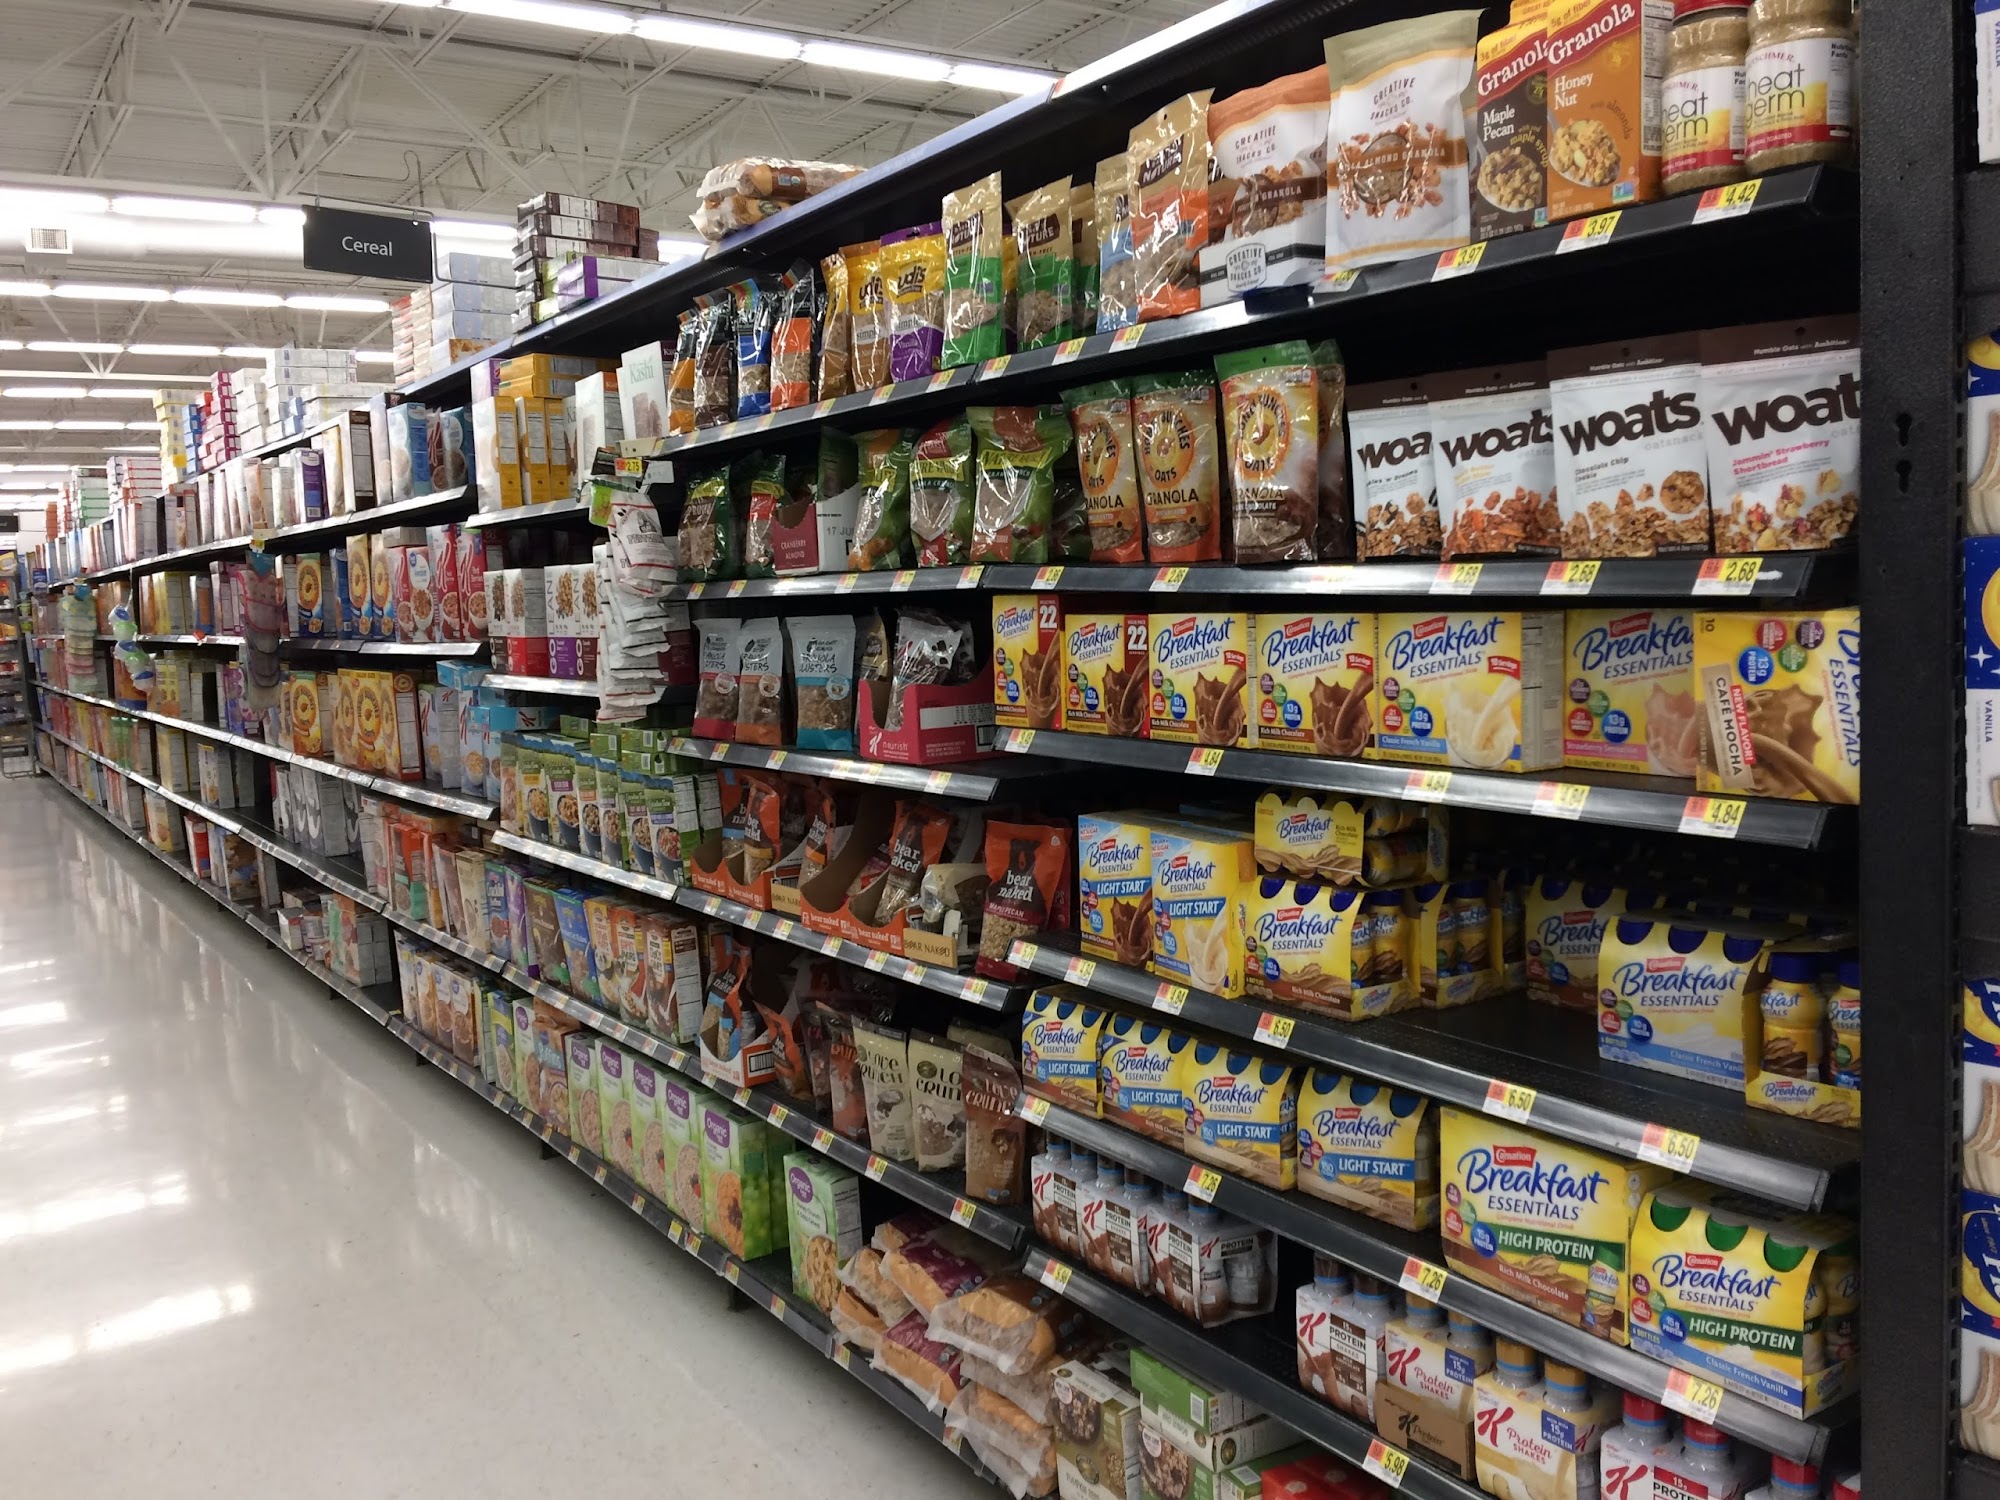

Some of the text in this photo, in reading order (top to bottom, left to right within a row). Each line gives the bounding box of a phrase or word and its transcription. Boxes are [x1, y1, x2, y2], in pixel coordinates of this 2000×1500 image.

[1549, 3, 1635, 65] Granola
[1373, 77, 1416, 105] CREATIVE
[1555, 72, 1594, 93] Honey
[1555, 93, 1578, 110] Nut
[1483, 105, 1515, 126] Maple
[1235, 125, 1276, 149] CREATIVE
[1483, 124, 1515, 142] Pecan
[1261, 186, 1302, 201] GRANOLA
[1726, 183, 1756, 205] 4.42
[1587, 216, 1616, 238] 3.97
[342, 236, 393, 256] Cereal
[1458, 246, 1481, 266] 3.97
[1228, 248, 1262, 266] CREATIVE
[629, 358, 654, 384] Kashi
[1560, 389, 1701, 456] woats
[1357, 432, 1432, 471] woa
[1776, 440, 1830, 456] Strawberry
[627, 461, 640, 472] 2.75
[1575, 456, 1629, 475] Chocolate Chip
[1733, 457, 1788, 476] Shortbread
[1154, 469, 1177, 483] OATS
[780, 539, 806, 549] CRANBERRY
[785, 551, 805, 560] ALMOND
[1568, 565, 1594, 583] 2.68
[1727, 562, 1756, 582] 2.68
[996, 608, 1037, 634] Breakfast
[1040, 605, 1058, 629] 22
[1705, 619, 1715, 632] 10
[1003, 624, 1030, 637] ESSENTIALS
[1068, 623, 1123, 656] Breakfast
[1128, 626, 1147, 650] 22
[1153, 617, 1236, 663] Breakfast
[1078, 644, 1113, 660] ESSENTIALS
[1262, 617, 1360, 667] Breakfast
[1385, 617, 1505, 671] Breakfast
[1170, 649, 1220, 669] ESSENTIALS
[1282, 650, 1341, 674] ESSENTIALS
[1409, 652, 1482, 678] ESSENTIALS
[1604, 649, 1693, 679] ESSENTIALS
[1748, 651, 1756, 681] PROTEIN
[1757, 657, 1769, 676] 13g
[1174, 697, 1184, 706] 13g
[1286, 703, 1300, 715] 13g
[1415, 711, 1428, 721] 13g
[1608, 714, 1625, 725] 13g
[1830, 659, 1860, 766] ESSENTIALS
[1732, 688, 1754, 761] NEW FLAVOR!
[1724, 719, 1743, 776] MOCHA
[1711, 803, 1741, 824] 4.84
[1276, 817, 1333, 840] Breakfast
[1288, 834, 1323, 844] ESSENTIALS
[1087, 842, 1143, 868] Breakfast
[1007, 870, 1031, 886] bear
[1098, 863, 1133, 874] ESSENTIALS
[1158, 858, 1216, 886] Breakfast
[997, 886, 1033, 902] naked
[1097, 881, 1145, 895] LIGHT START
[1170, 882, 1206, 893] ESSENTIALS
[1169, 900, 1219, 916] LIGHT START
[1255, 914, 1343, 942] Breakfast
[1272, 939, 1324, 951] ESSENTIALS
[1613, 960, 1748, 996] Breakfast
[1641, 995, 1720, 1007] ESSENTIALS
[1032, 1024, 1087, 1045] Breakfast
[1274, 1022, 1290, 1036] 6.50
[1043, 1046, 1075, 1054] ESSENTIALS
[1113, 1047, 1174, 1073] Breakfast
[1048, 1063, 1090, 1075] LIGHT START
[1125, 1073, 1162, 1082] ESSENTIALS
[1131, 1091, 1178, 1104] LIGHT START
[1194, 1080, 1268, 1104] Breakfast
[1509, 1089, 1531, 1109] 6.50
[1762, 1084, 1818, 1099] Breakfast
[1209, 1104, 1252, 1115] ESSENTIALS
[707, 1118, 727, 1137] Organic
[1217, 1124, 1272, 1139] LIGHT START
[1313, 1110, 1401, 1138] Breakfast
[1330, 1137, 1382, 1149] ESSENTIALS
[1667, 1136, 1695, 1160] 6.50
[1496, 1149, 1532, 1162] Carnation
[1338, 1158, 1406, 1175] LIGHT START
[1458, 1149, 1609, 1203] Breakfast
[791, 1173, 811, 1193] Organic
[1034, 1172, 1052, 1201] K
[1053, 1183, 1076, 1198] PROTEIN
[1202, 1171, 1219, 1192] 7.26
[1083, 1200, 1103, 1230] K
[1488, 1195, 1580, 1220] ESSENTIALS
[1106, 1211, 1131, 1228] PROTEIN
[1148, 1222, 1167, 1251] K
[1168, 1234, 1192, 1253] PROTEIN
[1473, 1238, 1494, 1252] PROTEIN
[1476, 1228, 1490, 1242] 15g
[1498, 1230, 1595, 1260] HIGH PROTEIN
[1422, 1268, 1442, 1291] 7.26
[1499, 1263, 1569, 1300] Rich Milk Chocolate
[1653, 1255, 1781, 1299] Breakfast
[1678, 1290, 1754, 1312] ESSENTIALS
[1299, 1312, 1327, 1347] K
[1663, 1324, 1684, 1338] PROTEIN
[1665, 1315, 1681, 1329] 15g
[1330, 1326, 1366, 1351] PROTEIN
[1689, 1317, 1796, 1350] HIGH PROTEIN
[1388, 1347, 1421, 1387] K
[1446, 1368, 1474, 1383] PROTEIN
[1452, 1359, 1465, 1374] 15g
[1706, 1356, 1789, 1397] Classic French Vanilla
[1413, 1366, 1454, 1394] Protein
[1420, 1381, 1450, 1400] SHAKES
[1692, 1382, 1718, 1409] 7.26
[1477, 1406, 1515, 1448] K
[1550, 1423, 1566, 1438] 15g
[1506, 1427, 1553, 1459] Protein
[1542, 1431, 1575, 1450] PROTEIN
[1385, 1452, 1406, 1476] 5.98
[1512, 1444, 1547, 1465] SHAKES
[1605, 1464, 1649, 1500] K
[1673, 1476, 1687, 1490] 15g
